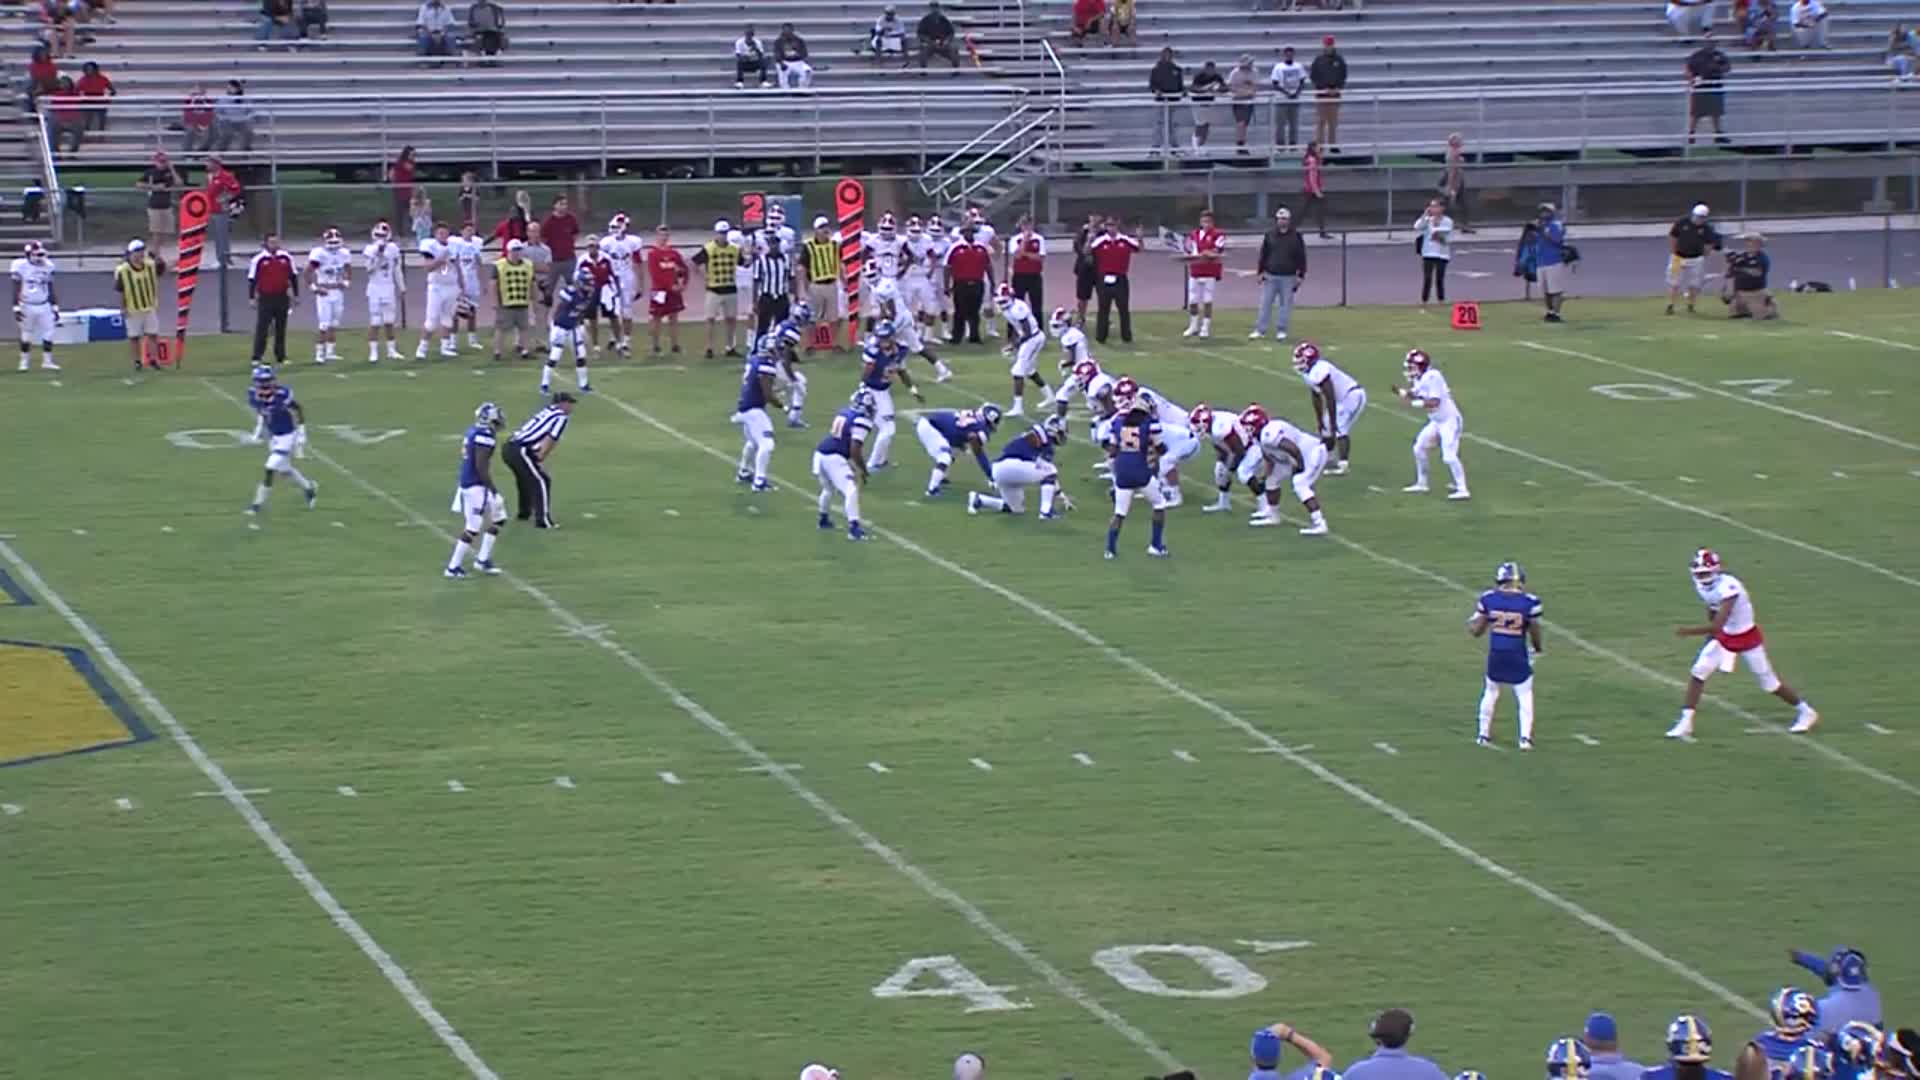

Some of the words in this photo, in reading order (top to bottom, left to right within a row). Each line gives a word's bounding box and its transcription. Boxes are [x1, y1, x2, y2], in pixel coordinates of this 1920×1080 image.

[743, 194, 763, 222] 2
[1458, 306, 1477, 324] 20
[1489, 609, 1523, 635] 22
